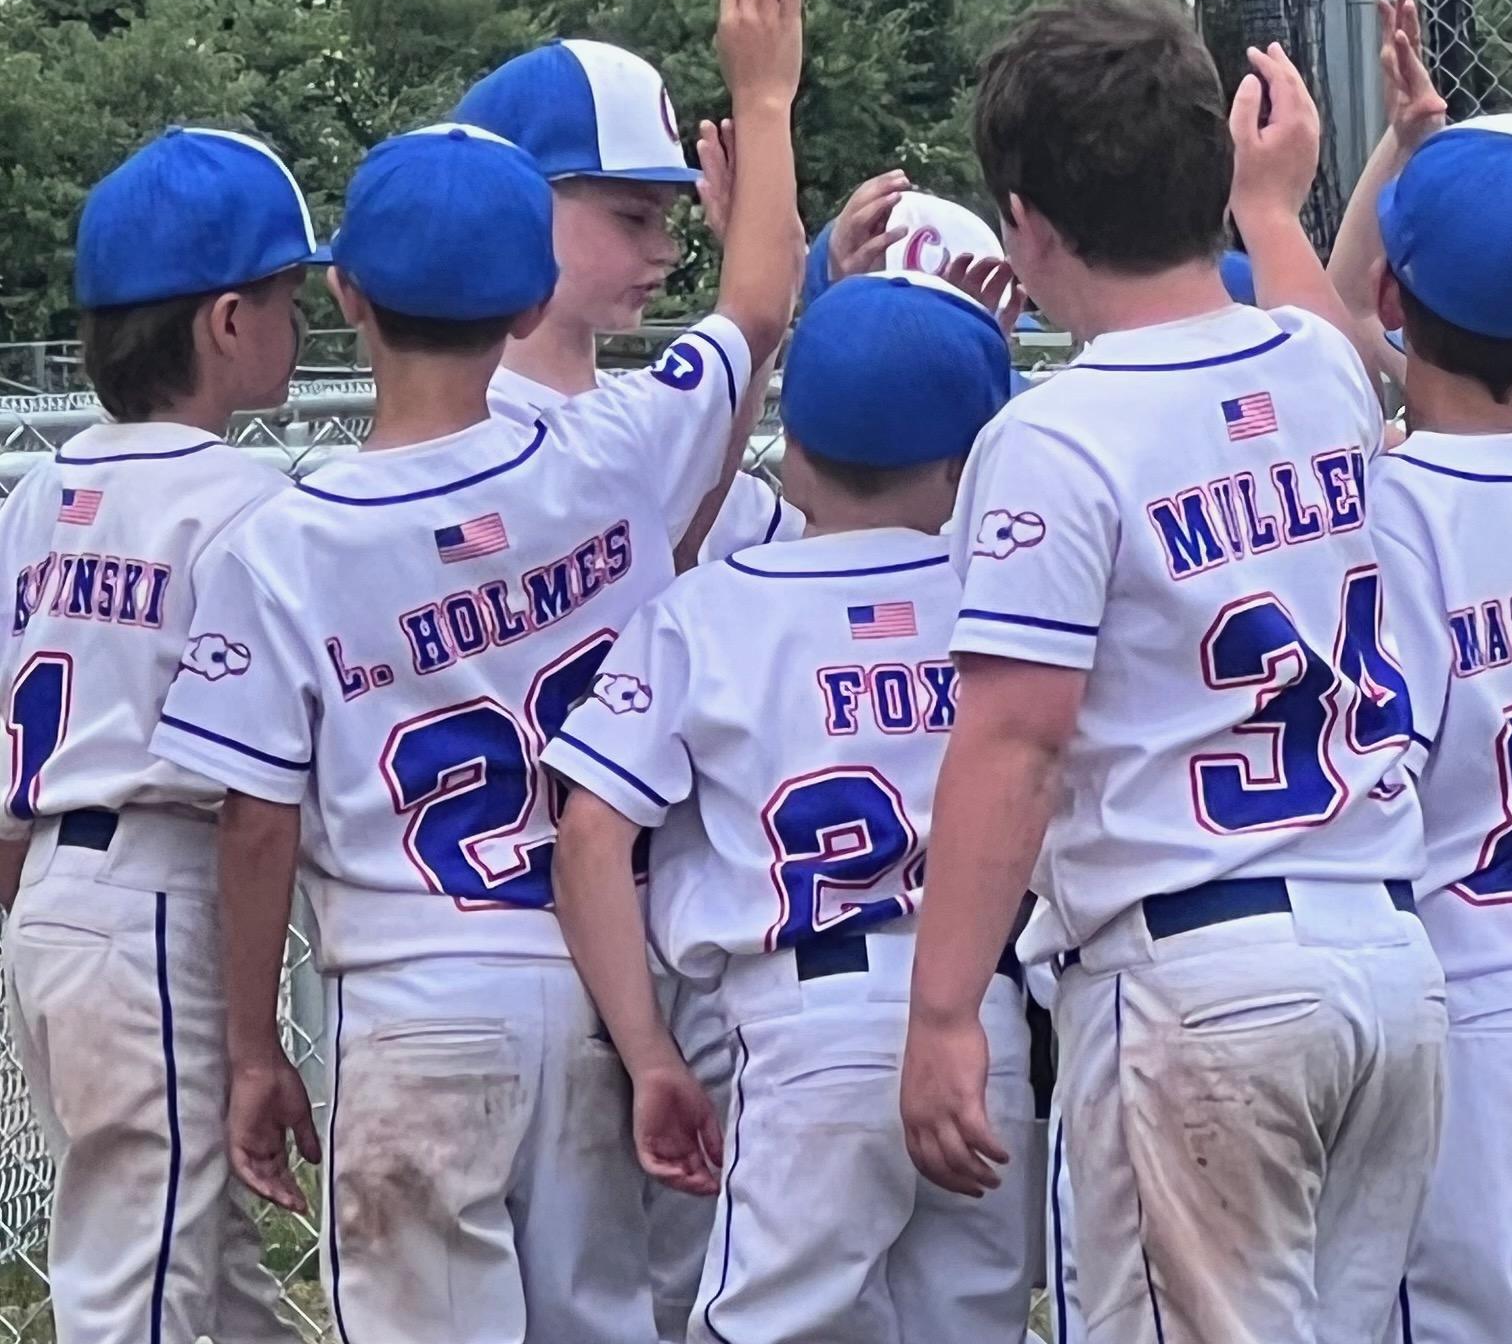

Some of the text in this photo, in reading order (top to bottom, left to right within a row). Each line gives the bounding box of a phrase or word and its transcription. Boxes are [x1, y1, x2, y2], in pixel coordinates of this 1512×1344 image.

[324, 518, 633, 703] L. HOLMES
[816, 659, 960, 736] FOX
[1189, 563, 1414, 836] 34
[760, 764, 928, 954] 2
